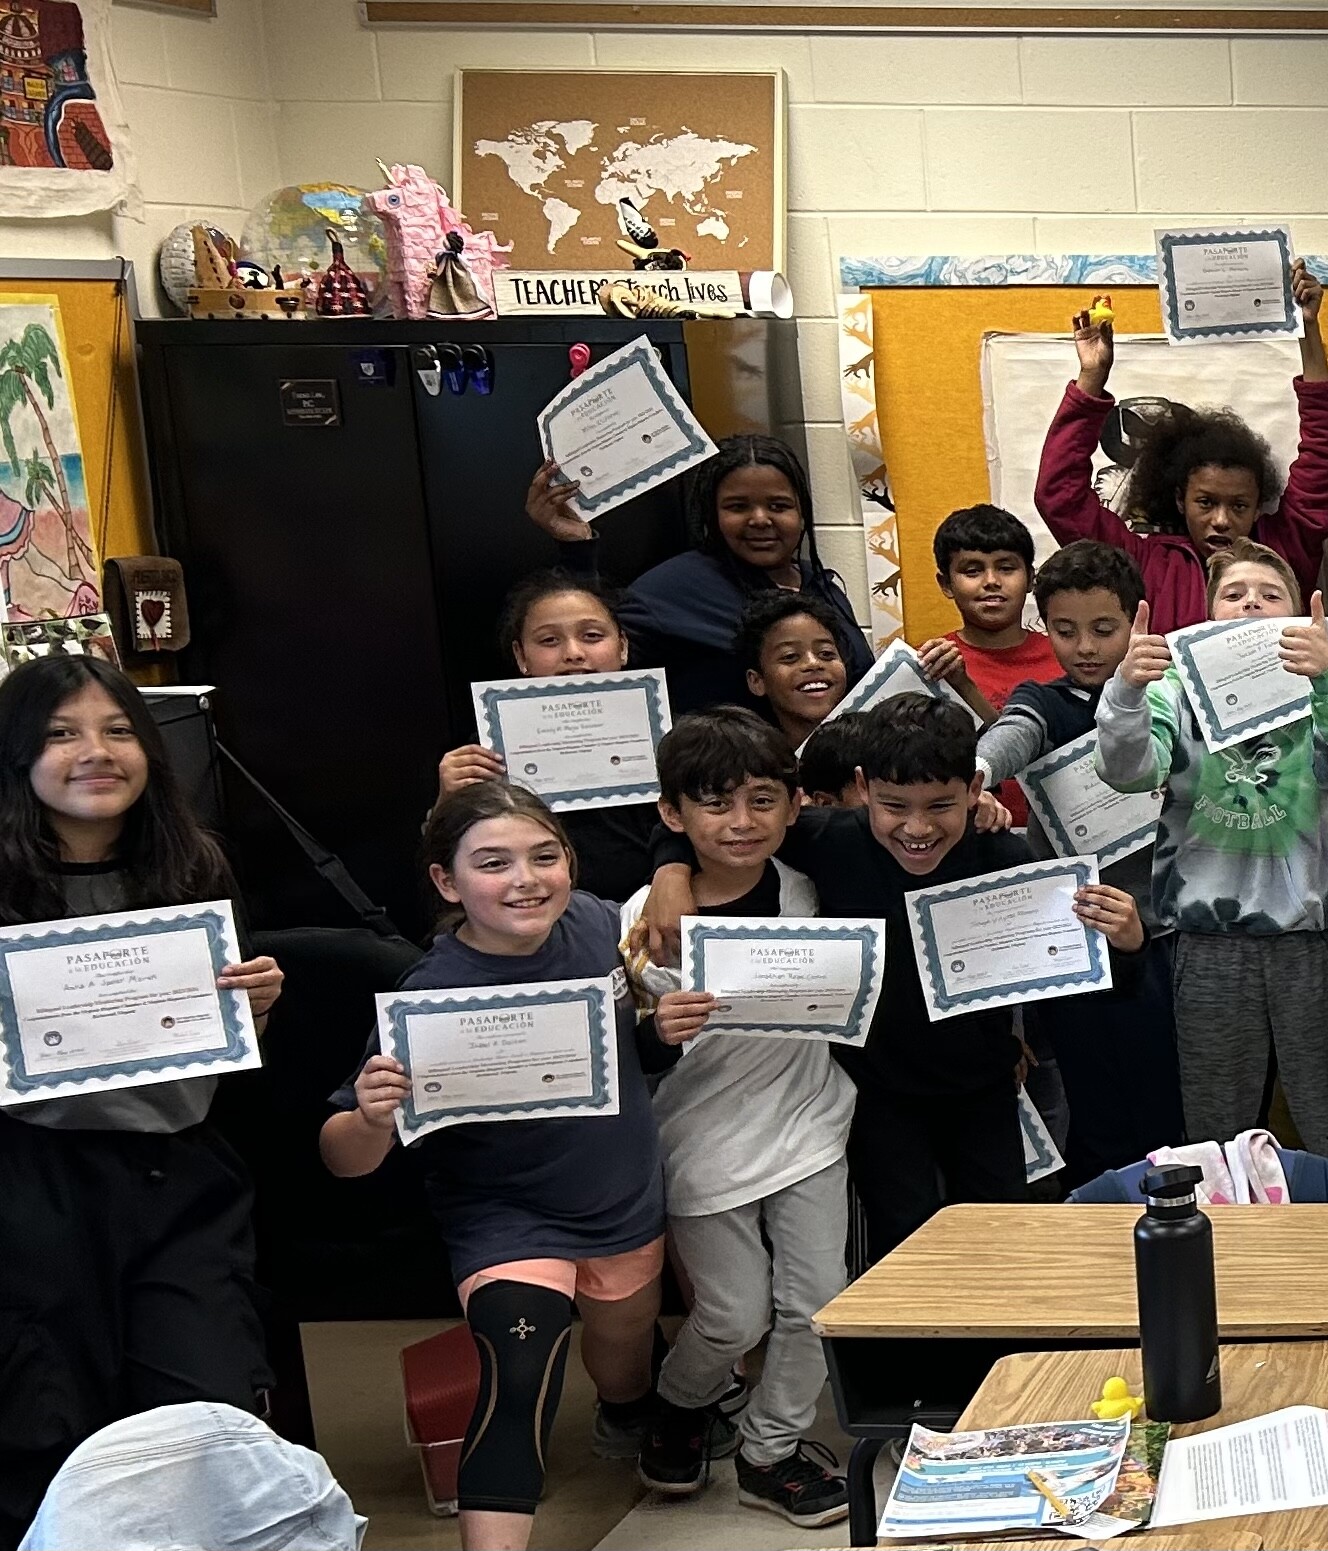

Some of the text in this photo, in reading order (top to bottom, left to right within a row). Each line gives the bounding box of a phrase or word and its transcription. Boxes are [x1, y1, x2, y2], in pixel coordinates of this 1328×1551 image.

[684, 278, 728, 302] lives
[1194, 795, 1288, 830] FOOTBALL
[66, 946, 150, 965] PASAPORTE
